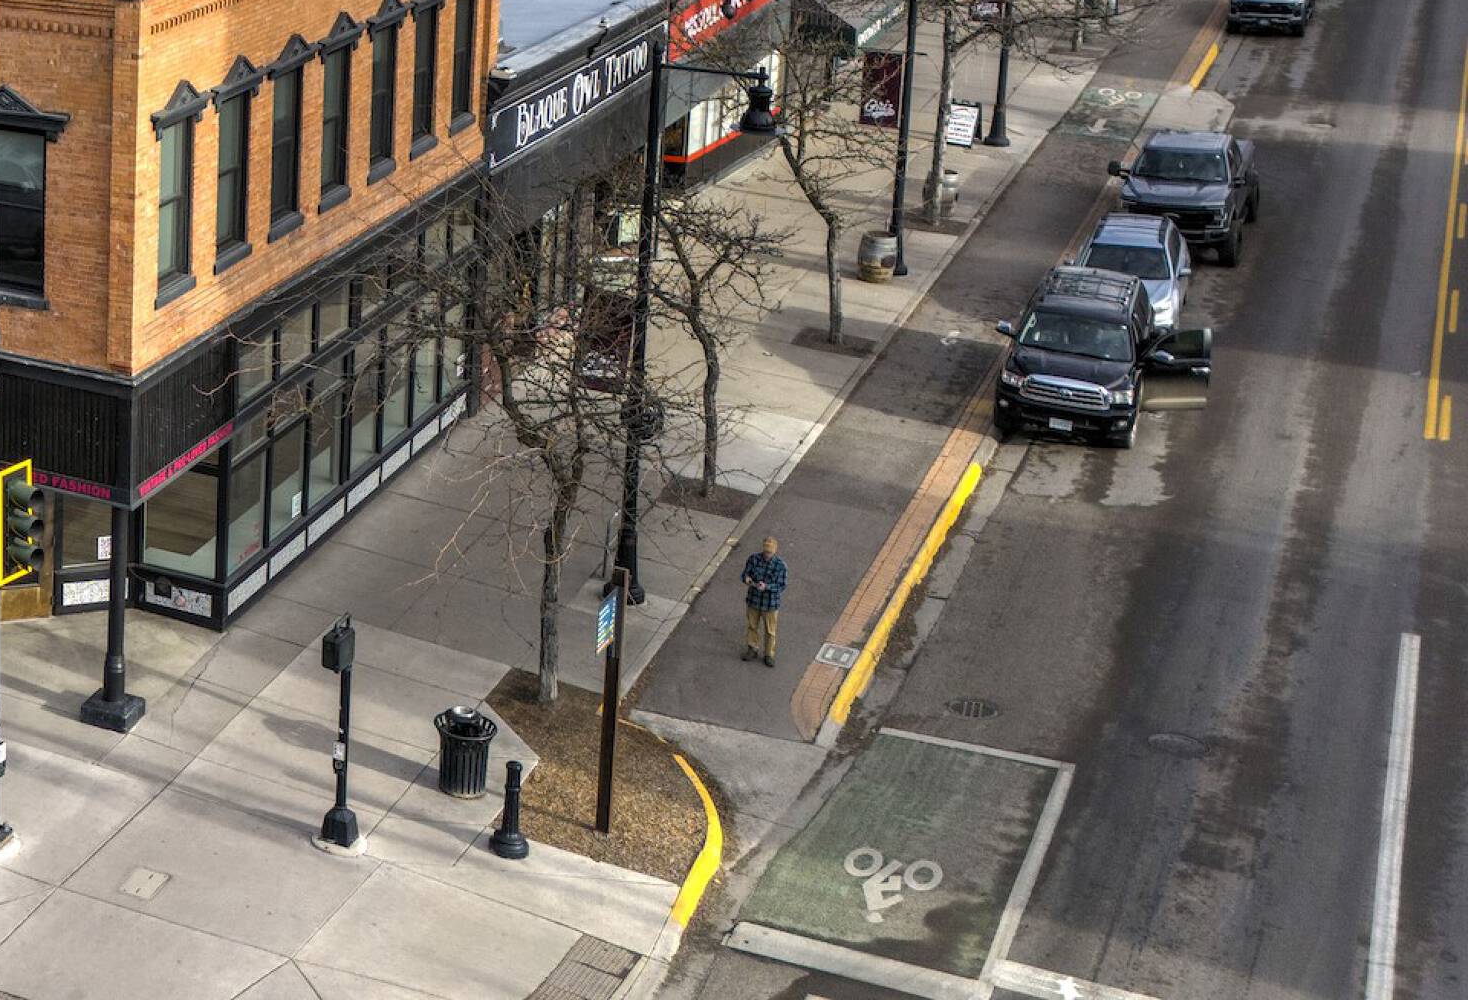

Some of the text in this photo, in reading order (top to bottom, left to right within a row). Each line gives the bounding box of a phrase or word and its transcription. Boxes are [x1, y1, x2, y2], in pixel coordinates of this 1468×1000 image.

[515, 41, 648, 148] BLAQUE OWL TATTOO
[52, 474, 111, 500] FASHION
